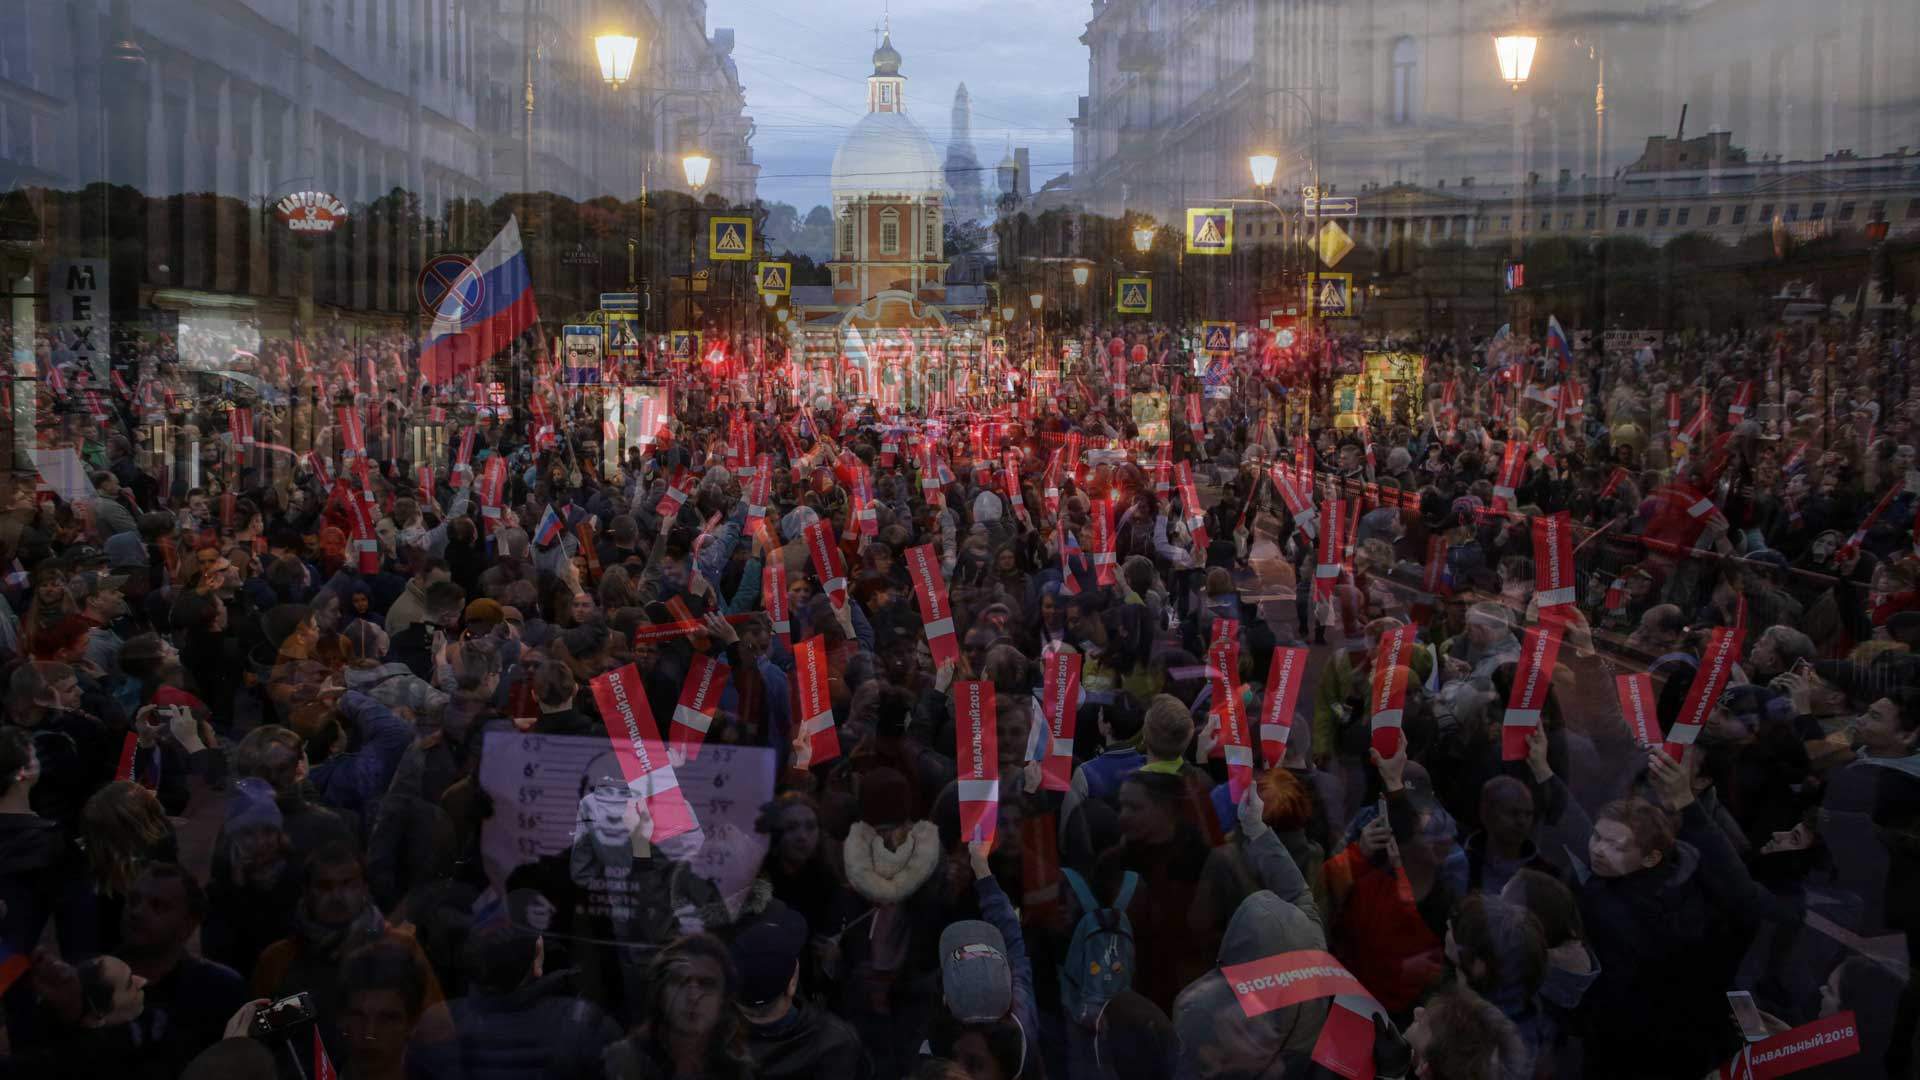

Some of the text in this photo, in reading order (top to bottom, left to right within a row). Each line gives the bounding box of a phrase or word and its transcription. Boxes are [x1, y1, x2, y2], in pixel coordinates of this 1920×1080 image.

[288, 219, 335, 231] DANDY
[607, 671, 653, 772] НАВАЛЬНЫЙ20!8
[968, 683, 984, 778] НАВАЛЬНЫЙ20!8
[1750, 1025, 1855, 1065] НАВАЛЬНЫЙ20!8
